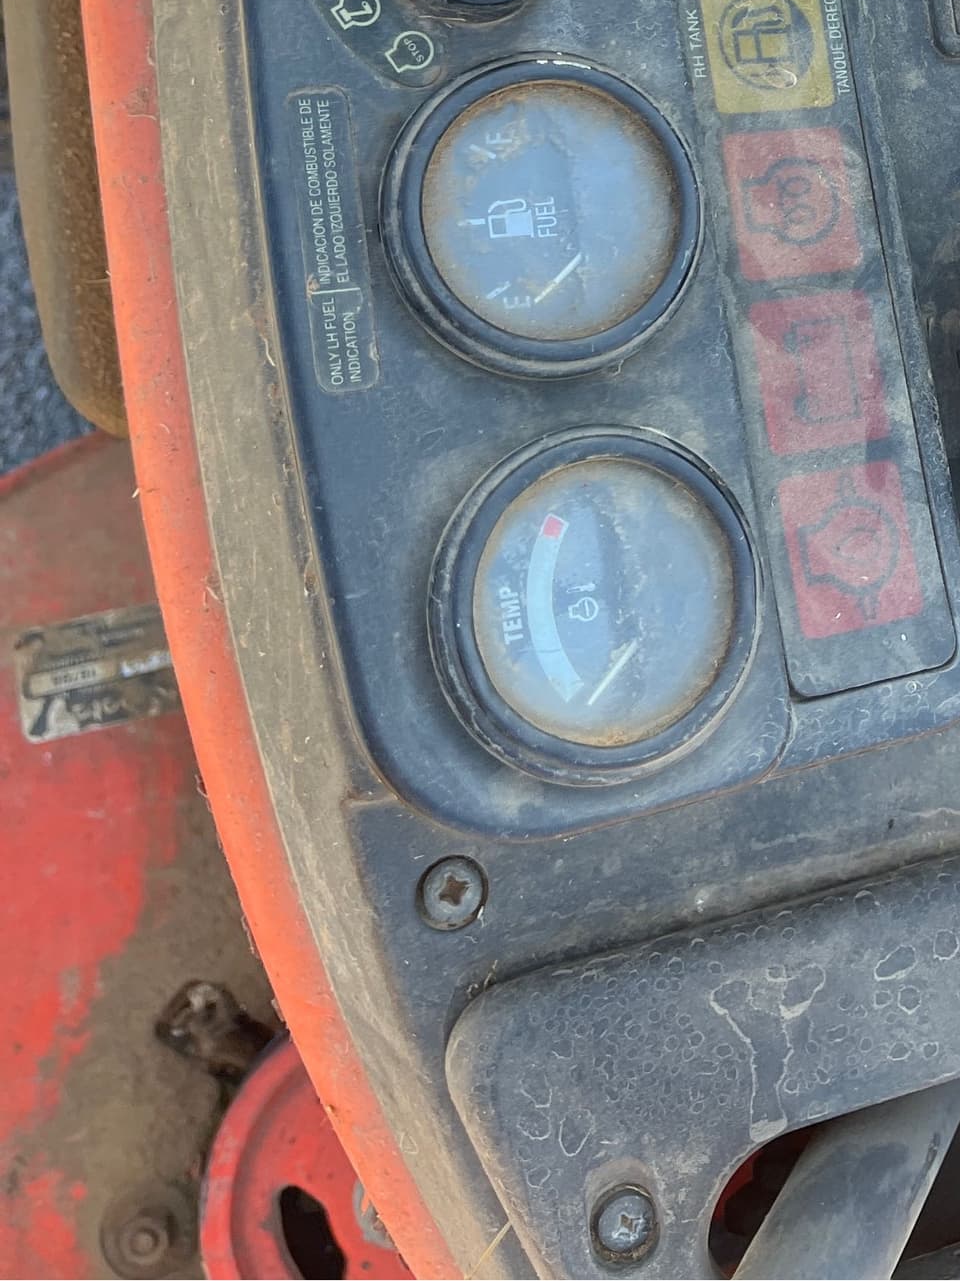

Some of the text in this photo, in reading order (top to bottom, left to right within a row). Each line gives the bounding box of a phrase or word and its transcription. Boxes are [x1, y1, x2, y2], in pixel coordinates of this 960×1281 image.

[403, 38, 425, 64] STOP
[685, 9, 707, 78] RH TANK
[831, 43, 851, 96] TANQUE
[486, 132, 513, 145] F
[298, 99, 331, 285] INDICACION DE COMBUSTIBLE DE
[316, 100, 350, 283] EL LADO IZQUIERDO SOLAMENTE
[534, 196, 558, 238] FUEL
[503, 295, 531, 309] E
[322, 297, 344, 385] ONLY LH FUEL
[342, 312, 362, 383] INDICATION
[499, 586, 523, 645] TEMP
